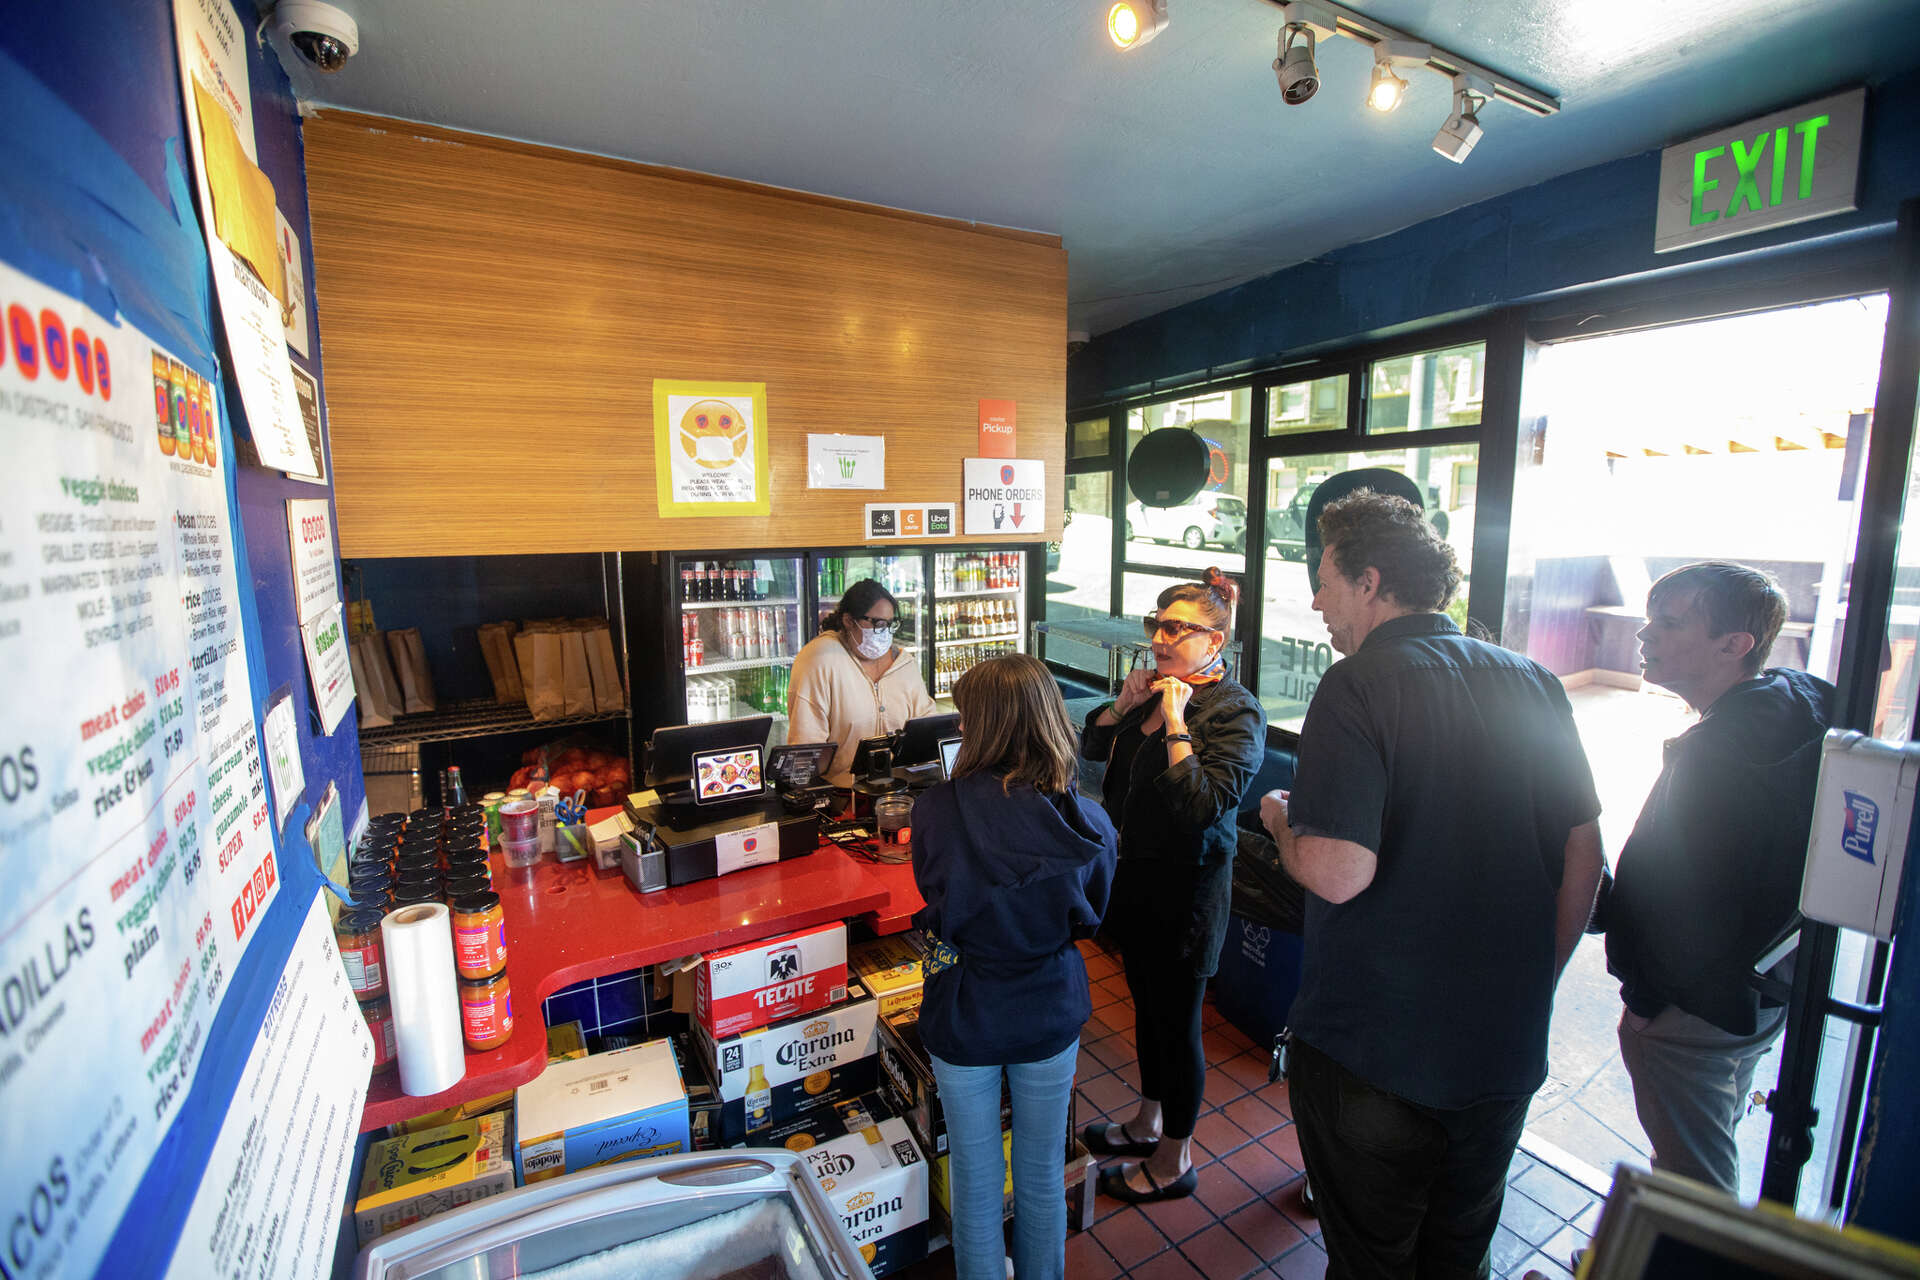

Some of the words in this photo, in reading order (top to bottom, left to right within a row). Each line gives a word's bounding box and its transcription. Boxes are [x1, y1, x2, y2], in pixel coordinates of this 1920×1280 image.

[1690, 114, 1829, 226] EXIT
[0, 302, 112, 402] LOTE
[983, 423, 1013, 435] Pickup
[60, 477, 106, 506] veggie
[108, 480, 139, 504] choices
[969, 488, 1003, 501] PHONE
[1005, 488, 1042, 501] ORDERS
[177, 509, 196, 529] bean
[197, 510, 217, 529] choices
[930, 514, 948, 522] Uber
[931, 522, 948, 530] Eats
[186, 589, 201, 610] rice
[202, 586, 222, 605] choices
[192, 644, 218, 671] tortilla
[218, 638, 237, 659] choices
[81, 704, 119, 742] meat
[155, 667, 180, 698] $10.95
[87, 735, 134, 776] veggie
[208, 766, 223, 791] sour
[223, 749, 243, 774] cream
[93, 782, 123, 819] rice
[164, 728, 184, 759] $7.50
[212, 784, 233, 814] cheese
[216, 795, 248, 846] guacamole
[1844, 798, 1875, 854] Purell
[110, 856, 145, 903] meat
[174, 789, 196, 828] $10.50
[219, 830, 243, 873] SUPER
[116, 884, 158, 936] veggie
[124, 924, 159, 980] plain
[939, 950, 952, 964] Cal
[753, 976, 816, 1009] TECATE
[141, 996, 173, 1056] meat
[147, 1022, 183, 1084] veggie
[726, 1048, 740, 1061] 24
[776, 1028, 856, 1067] Corona
[799, 1053, 837, 1073] Extra
[155, 1073, 179, 1122] rice
[380, 1159, 405, 1190] Chico
[525, 1155, 561, 1169] Modelo
[816, 1153, 855, 1179] Cor
[900, 1153, 917, 1165] 24
[10, 1154, 70, 1271] COS
[849, 1224, 883, 1242] xtra
